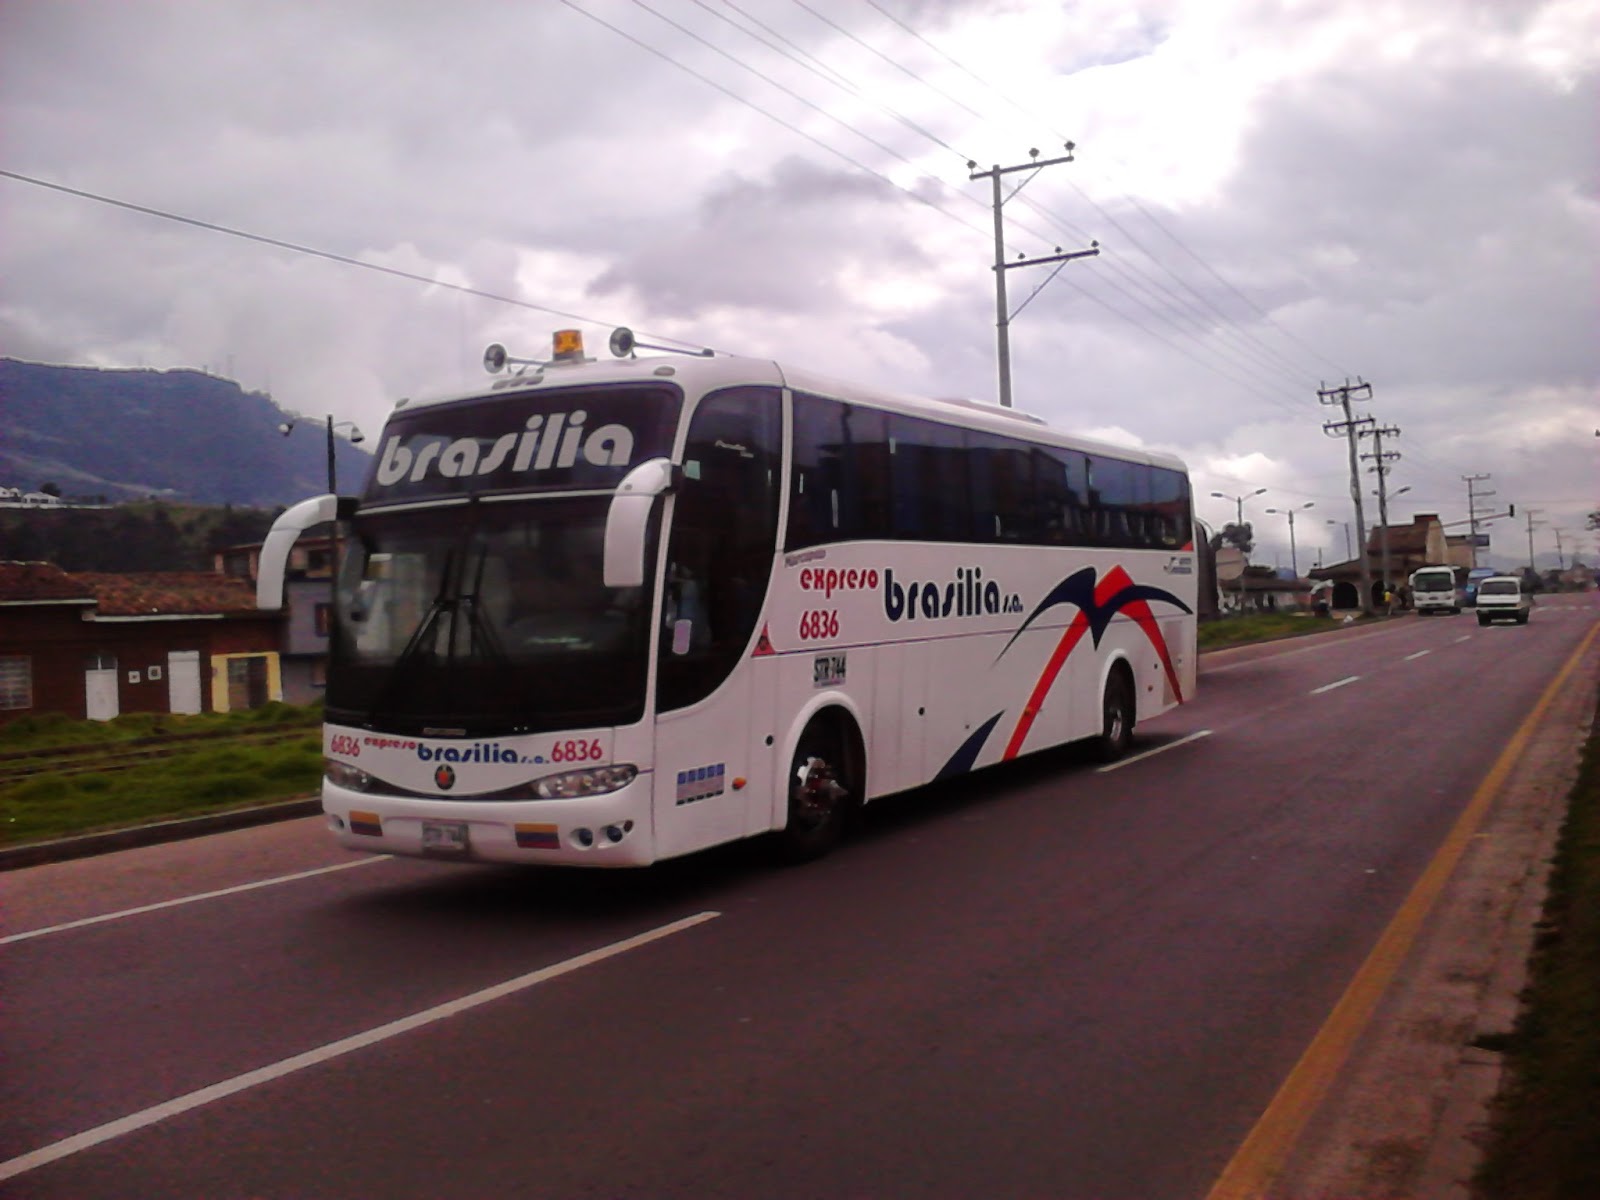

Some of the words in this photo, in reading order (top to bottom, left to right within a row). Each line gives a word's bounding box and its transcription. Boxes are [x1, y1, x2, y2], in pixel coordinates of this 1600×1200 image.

[377, 410, 634, 486] brasilia
[800, 568, 878, 599] expreso
[885, 567, 1000, 622] brasilia
[800, 610, 839, 640] 6836
[331, 734, 360, 757] 6836
[417, 743, 518, 763] brasilia
[552, 738, 603, 763] 6836
